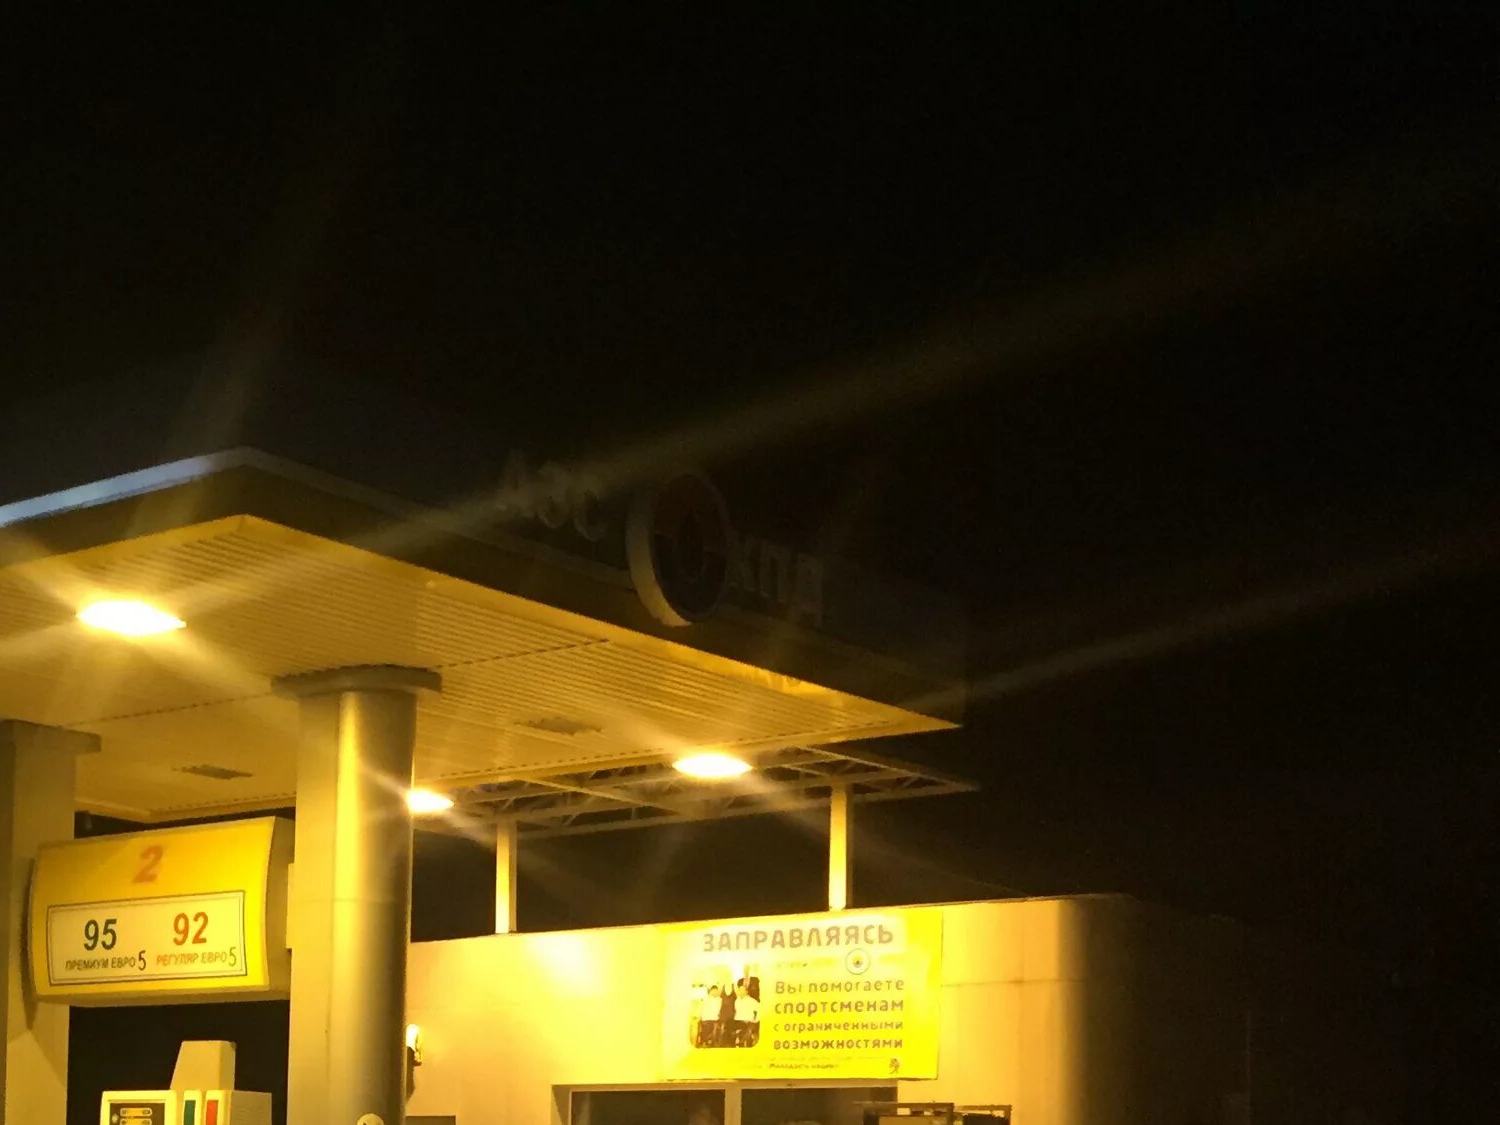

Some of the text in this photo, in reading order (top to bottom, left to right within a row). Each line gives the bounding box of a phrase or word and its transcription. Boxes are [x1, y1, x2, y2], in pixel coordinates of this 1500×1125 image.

[132, 845, 164, 884] 2
[83, 911, 209, 951] 95 92
[703, 924, 894, 952] ЗАПРАВЛЯЯСЬ
[775, 979, 905, 994] Вы помогаете
[774, 999, 904, 1017] спортсменам
[784, 1021, 903, 1034] ограниченными
[773, 1039, 903, 1050] возможностями
